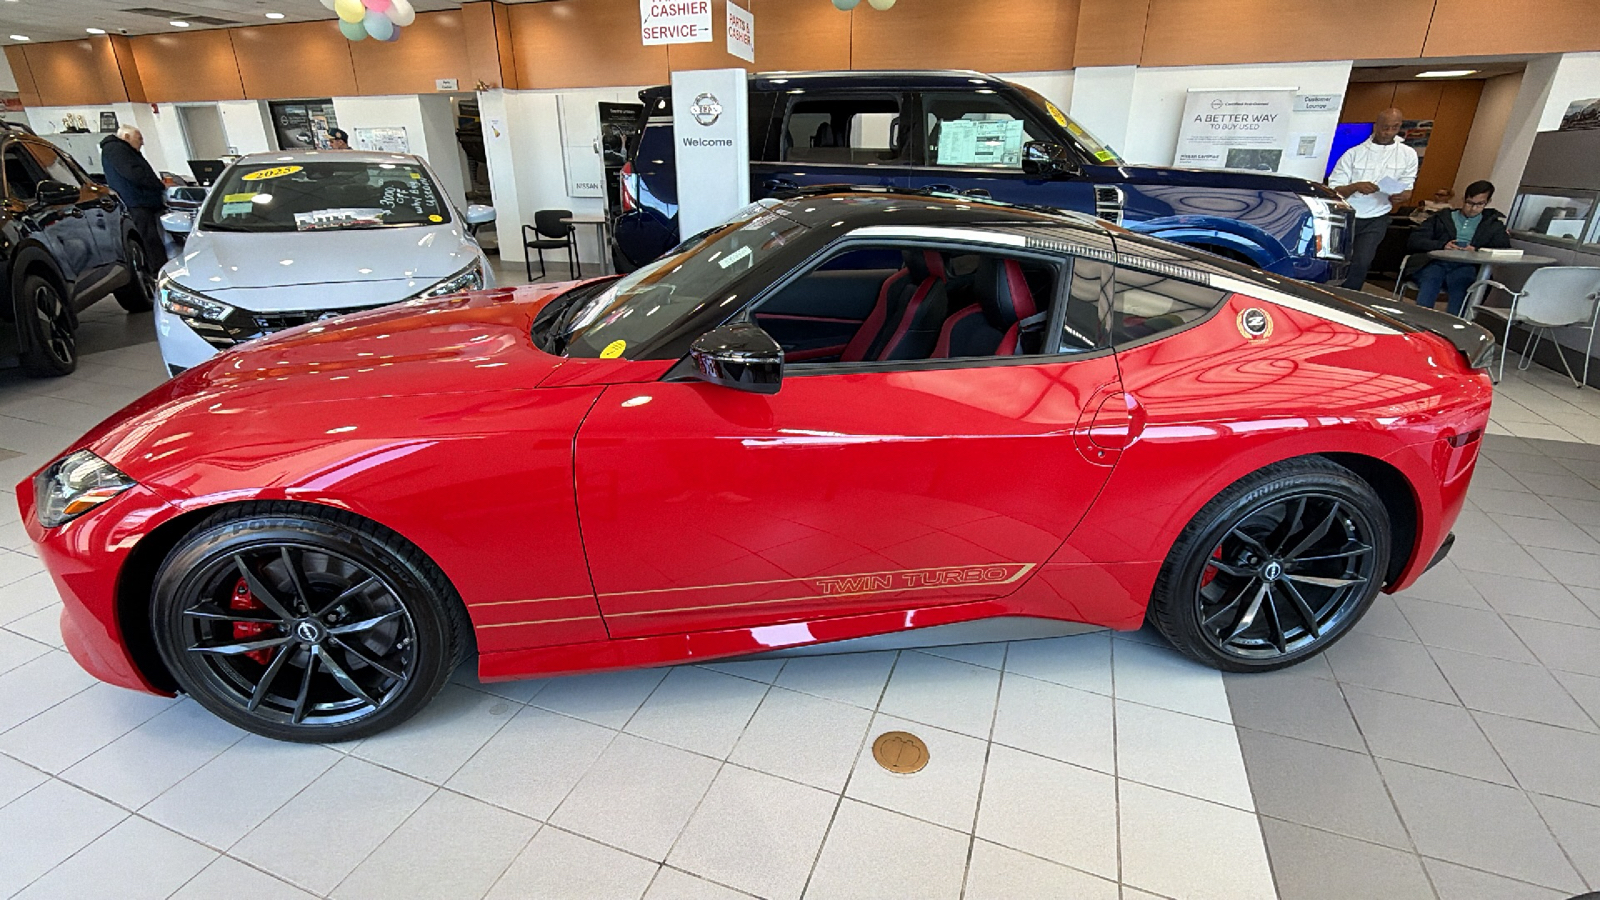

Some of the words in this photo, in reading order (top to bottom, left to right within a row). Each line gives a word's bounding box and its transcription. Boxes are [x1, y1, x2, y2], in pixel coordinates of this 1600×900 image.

[651, 1, 707, 17] CASHIER
[729, 13, 745, 31] PARTS
[643, 24, 698, 39] SERVICE
[728, 26, 751, 46] CASHIER
[1194, 114, 1203, 122] A
[1204, 114, 1249, 122] BETTER
[1251, 113, 1278, 122] WAY
[682, 138, 733, 147] Welcome
[256, 168, 290, 178] 2025
[816, 575, 892, 594] TWIN
[902, 567, 1007, 587] TURBO
